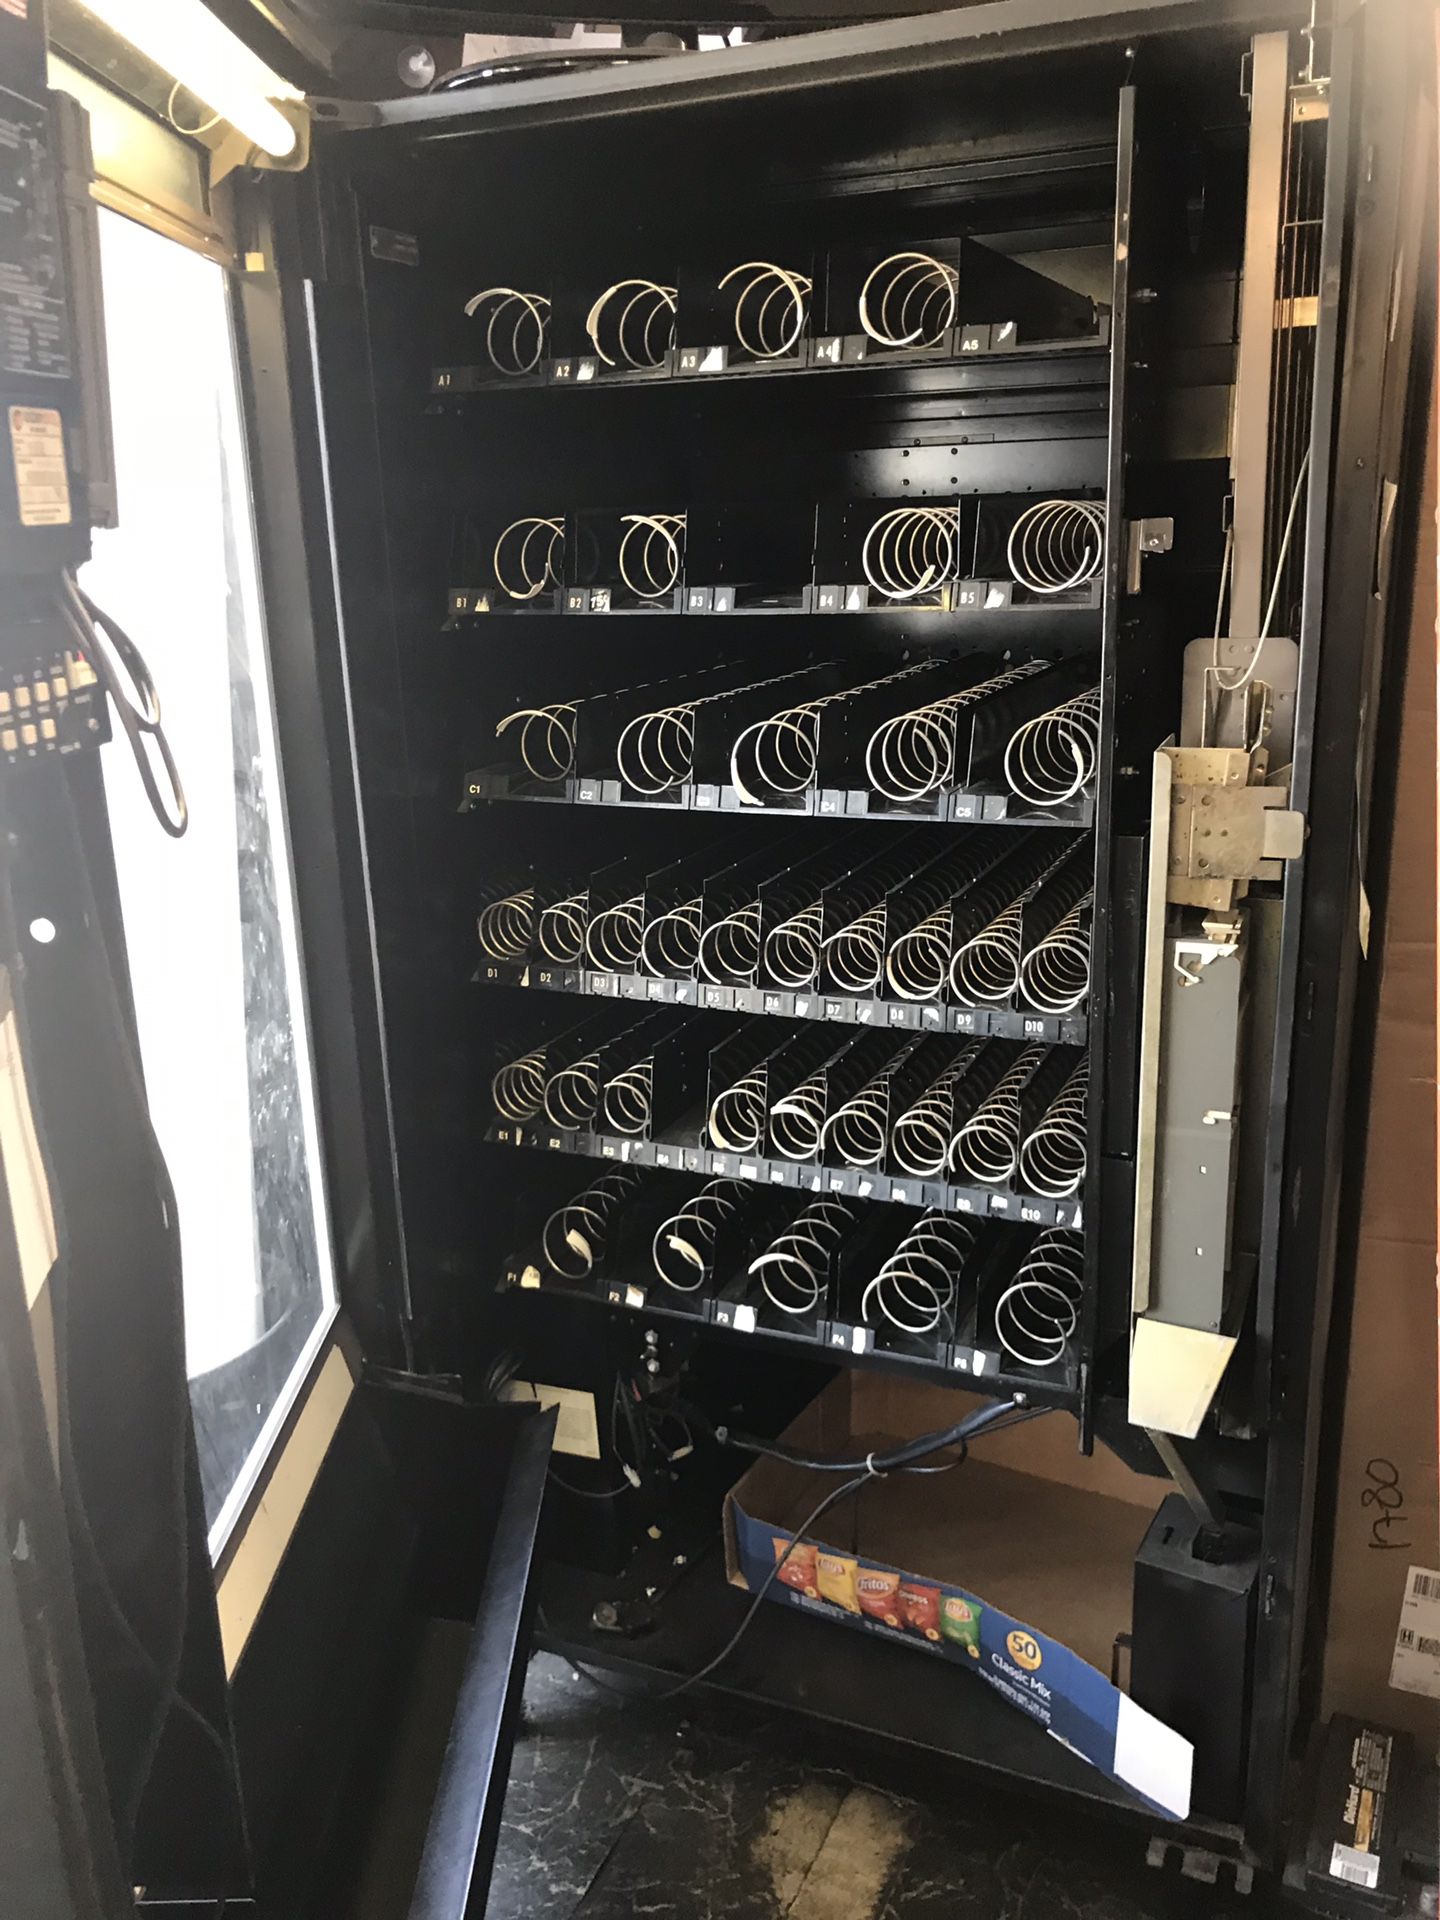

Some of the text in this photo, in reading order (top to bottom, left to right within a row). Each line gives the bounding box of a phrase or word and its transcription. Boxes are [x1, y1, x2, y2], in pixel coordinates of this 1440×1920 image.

[817, 344, 832, 358] A4
[962, 339, 979, 351] A5
[681, 355, 696, 368] A3
[556, 366, 570, 377] A2
[438, 375, 451, 386] A1
[456, 597, 468, 608] B1
[569, 597, 582, 609] B2
[690, 596, 703, 607] B3
[819, 595, 834, 606] B4
[961, 592, 975, 604] B5
[469, 784, 481, 794] C1
[580, 790, 593, 800] C2
[955, 806, 972, 818] C5
[487, 967, 499, 978] D1
[540, 972, 552, 983] D2
[707, 991, 721, 1003] D5
[766, 996, 779, 1008] D6
[827, 1003, 842, 1015] D7
[957, 1013, 972, 1025] D9
[1025, 1020, 1044, 1033] D10
[498, 1130, 509, 1141] E1
[549, 1138, 561, 1149] E2
[608, 1290, 621, 1302] F2
[717, 1311, 729, 1323] F3
[1011, 1633, 1038, 1661] 50
[992, 1653, 1029, 1686] Classic
[1030, 1676, 1052, 1701] Mix
